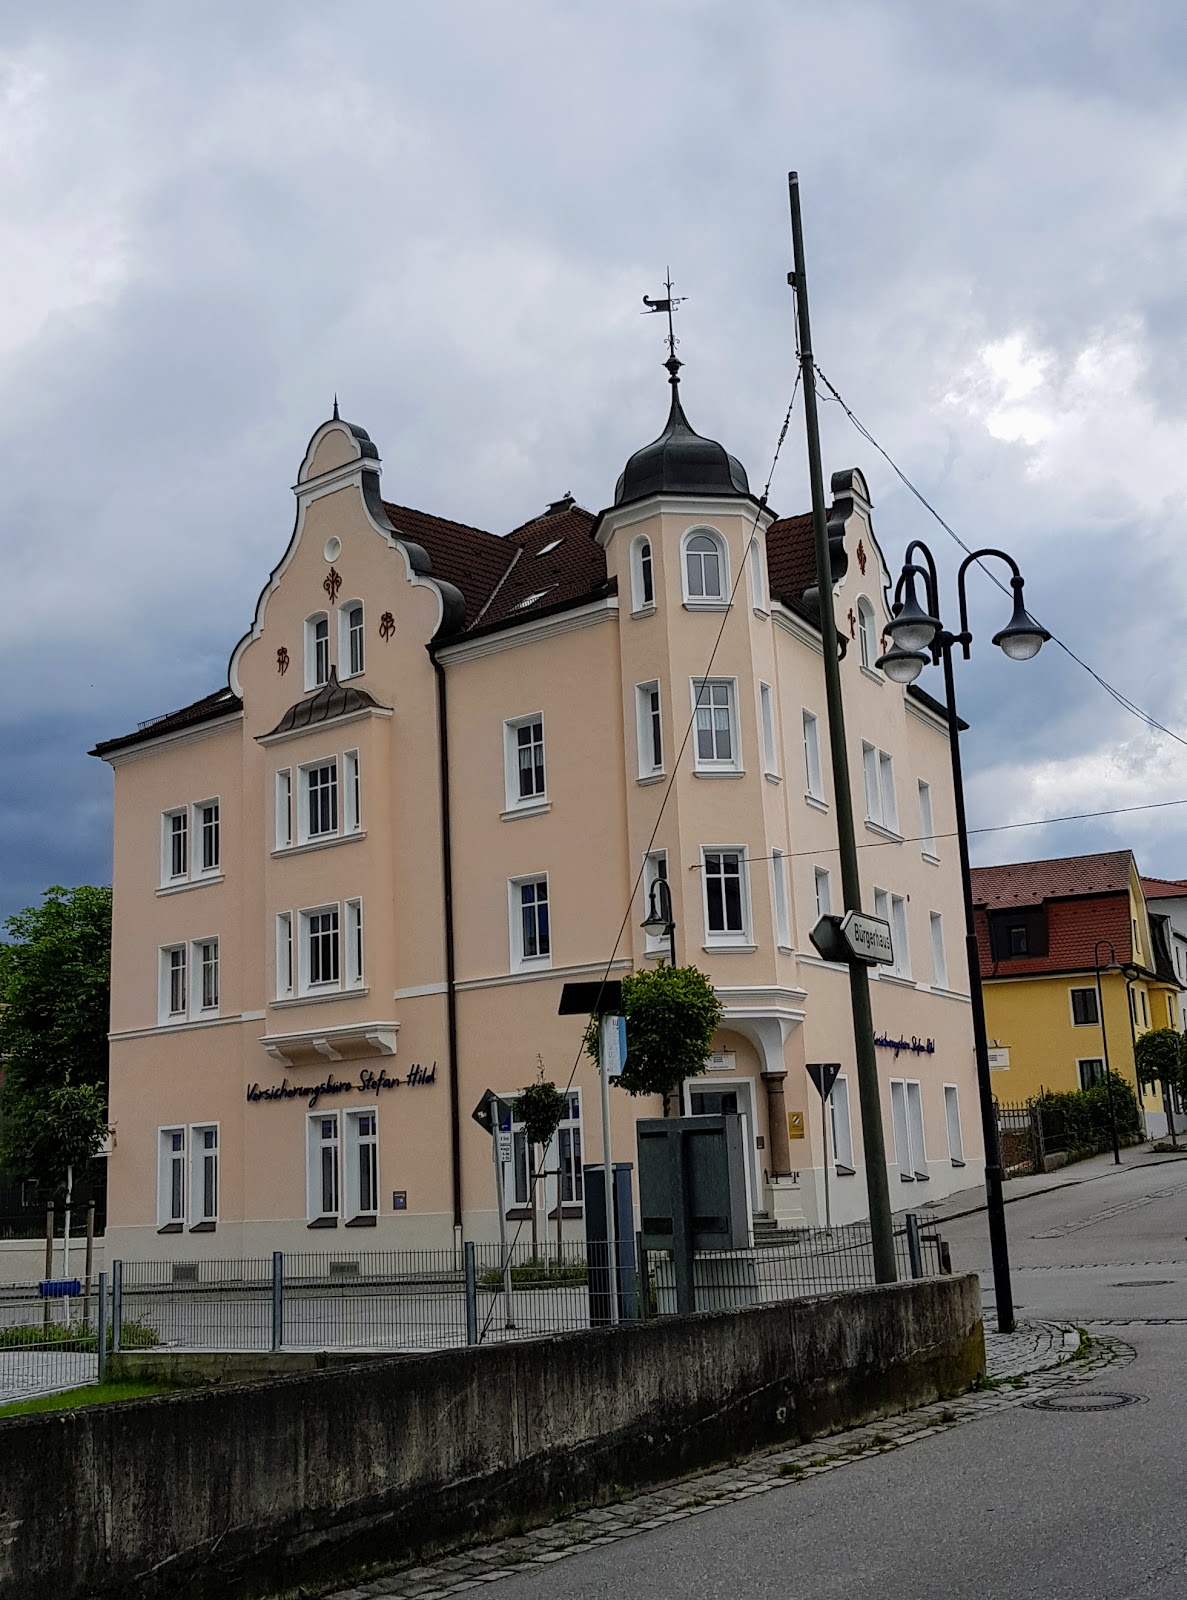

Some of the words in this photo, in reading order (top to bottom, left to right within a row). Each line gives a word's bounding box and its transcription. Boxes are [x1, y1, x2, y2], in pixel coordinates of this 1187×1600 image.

[854, 923, 891, 950] Bürgerhaus
[246, 1074, 351, 1108] Versicherungsbüro
[357, 1069, 400, 1097] Stefan
[407, 1061, 437, 1087] Hild
